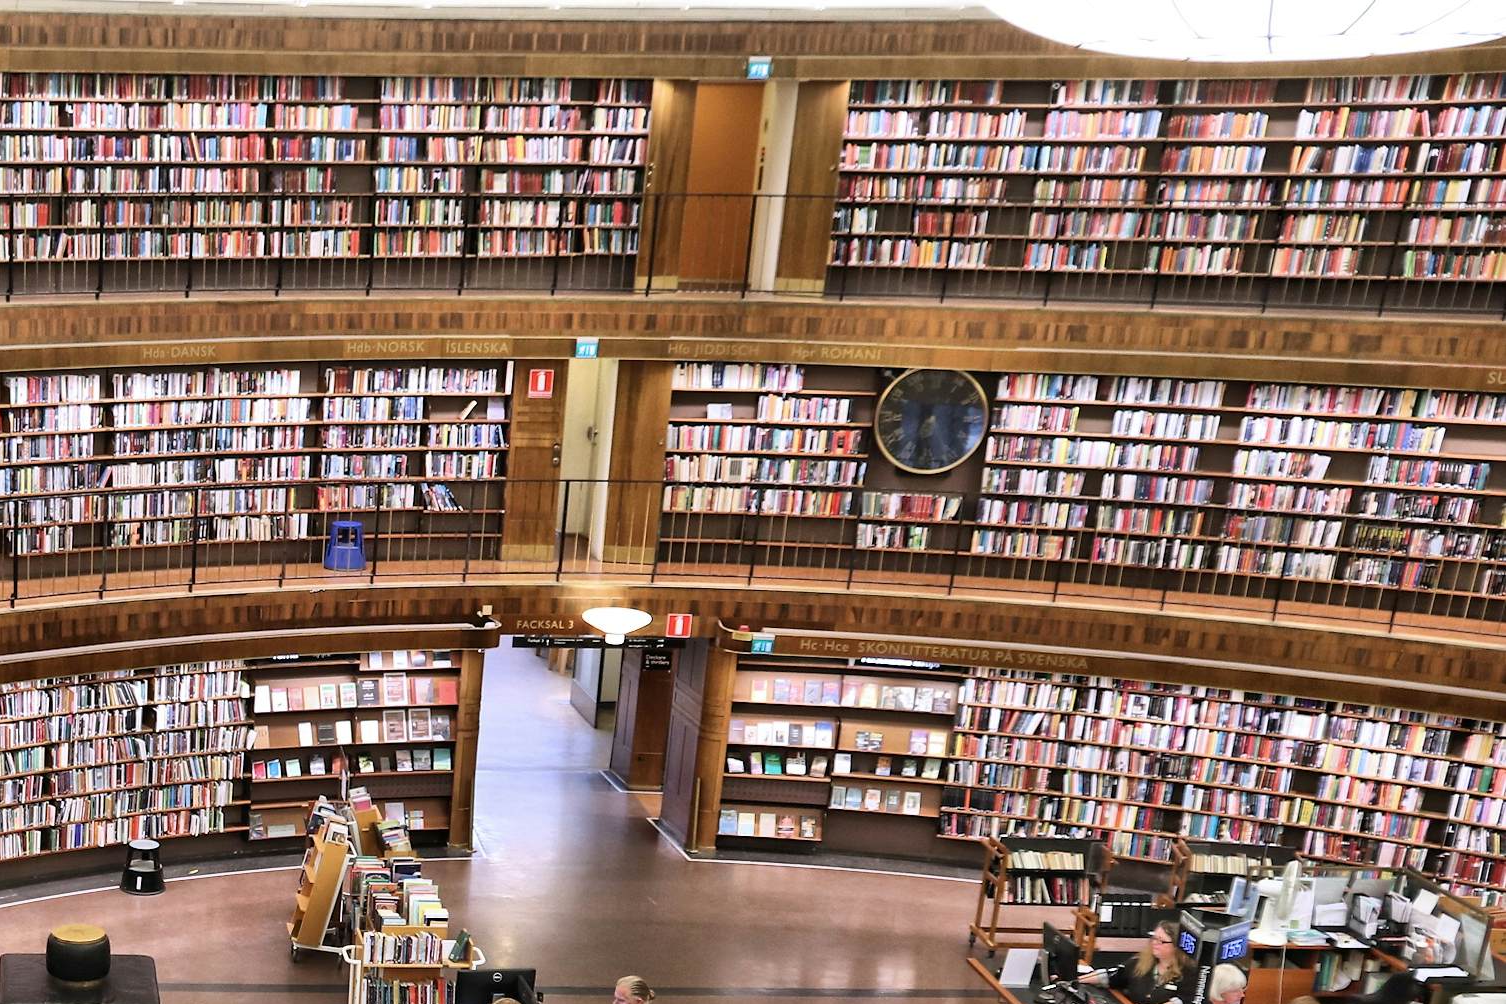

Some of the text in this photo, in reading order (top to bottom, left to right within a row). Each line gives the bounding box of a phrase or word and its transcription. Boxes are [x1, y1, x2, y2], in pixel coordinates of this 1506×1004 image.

[694, 343, 760, 357] JIDDISCH
[821, 346, 883, 360] ROMANI
[516, 620, 574, 630] FACKSAL 3
[995, 649, 1014, 663] PÅ
[1017, 652, 1089, 669] SVENSKA
